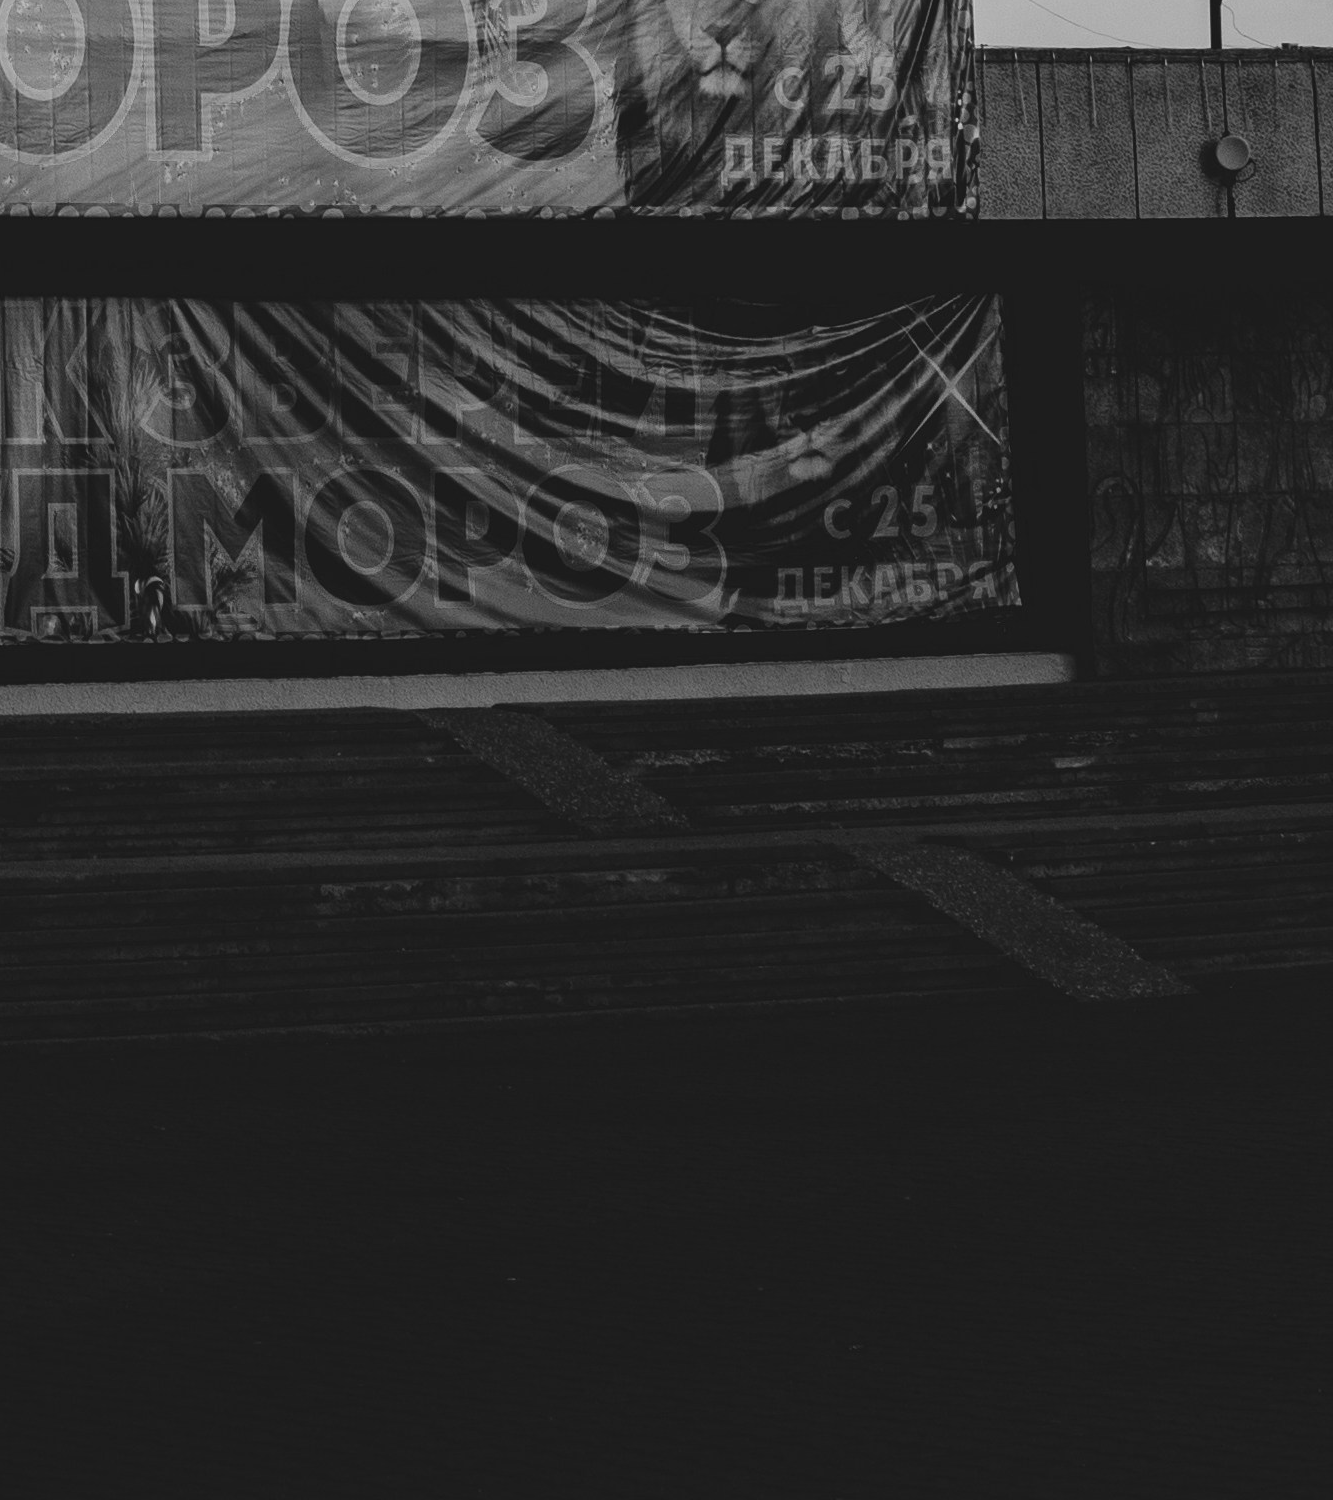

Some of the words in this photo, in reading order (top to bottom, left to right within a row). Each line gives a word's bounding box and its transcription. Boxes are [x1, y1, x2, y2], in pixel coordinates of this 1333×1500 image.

[823, 55, 898, 111] 25
[721, 137, 953, 186] ДЕКАБРЯ
[167, 465, 728, 613] МОРОЗ
[870, 485, 938, 539] 25
[774, 561, 997, 613] ДЕКАБРЯ
